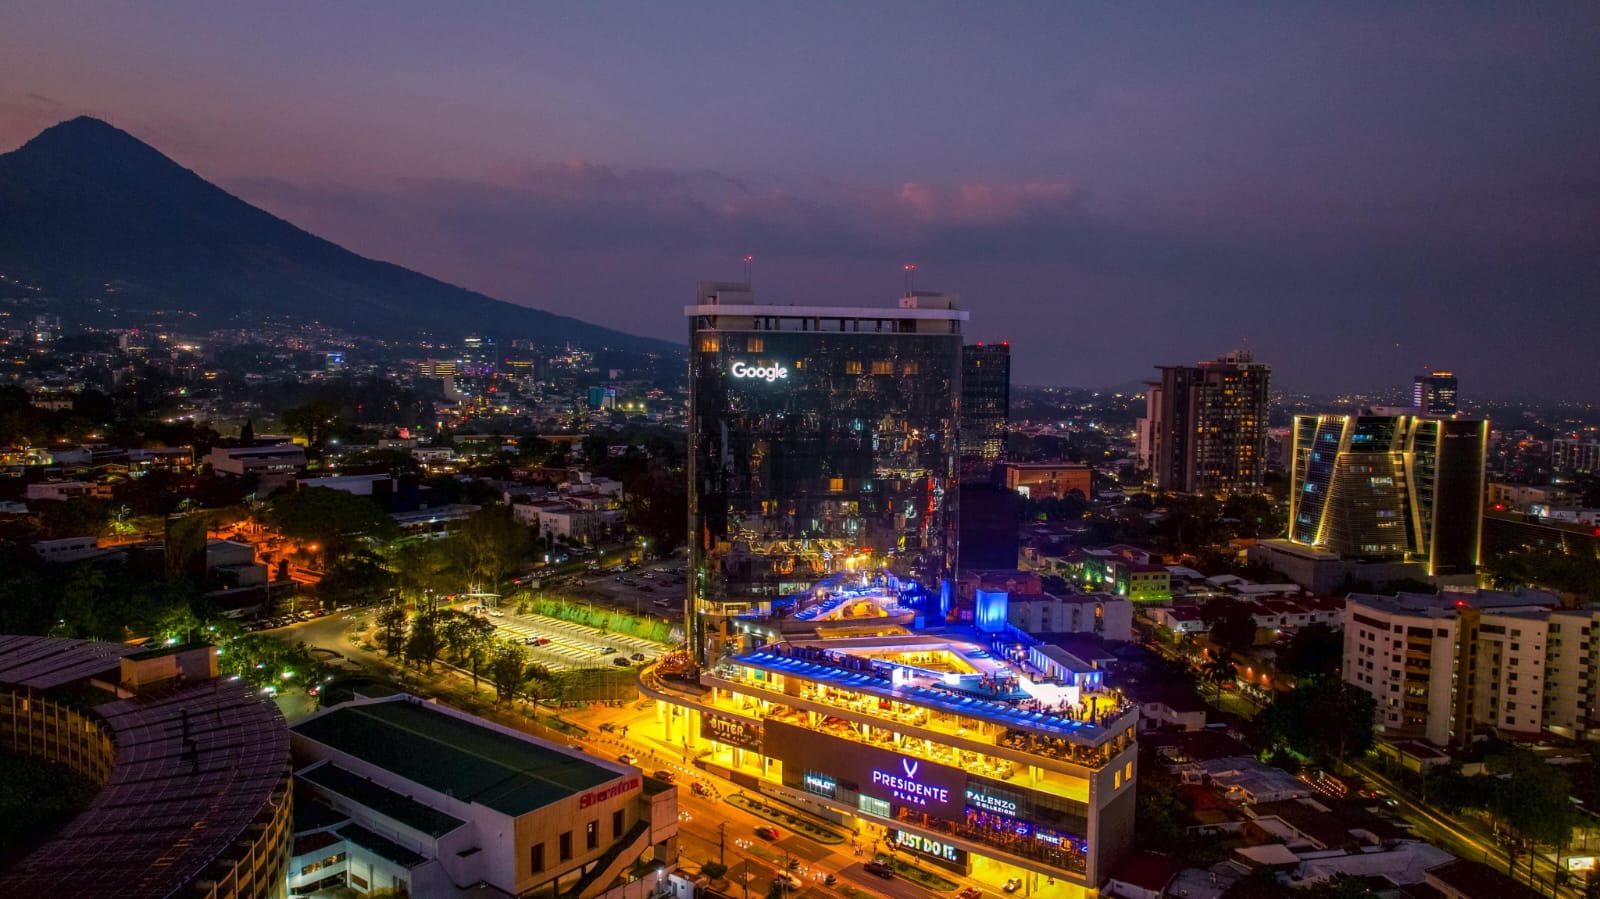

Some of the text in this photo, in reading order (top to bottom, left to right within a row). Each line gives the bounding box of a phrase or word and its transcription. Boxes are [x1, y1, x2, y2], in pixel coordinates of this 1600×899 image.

[732, 361, 788, 382] Google
[873, 770, 948, 803] PRESIDENTE
[893, 790, 926, 806] PLAZA
[966, 790, 1016, 810] PALENZO
[896, 830, 922, 850] JUST
[923, 838, 941, 856] DO
